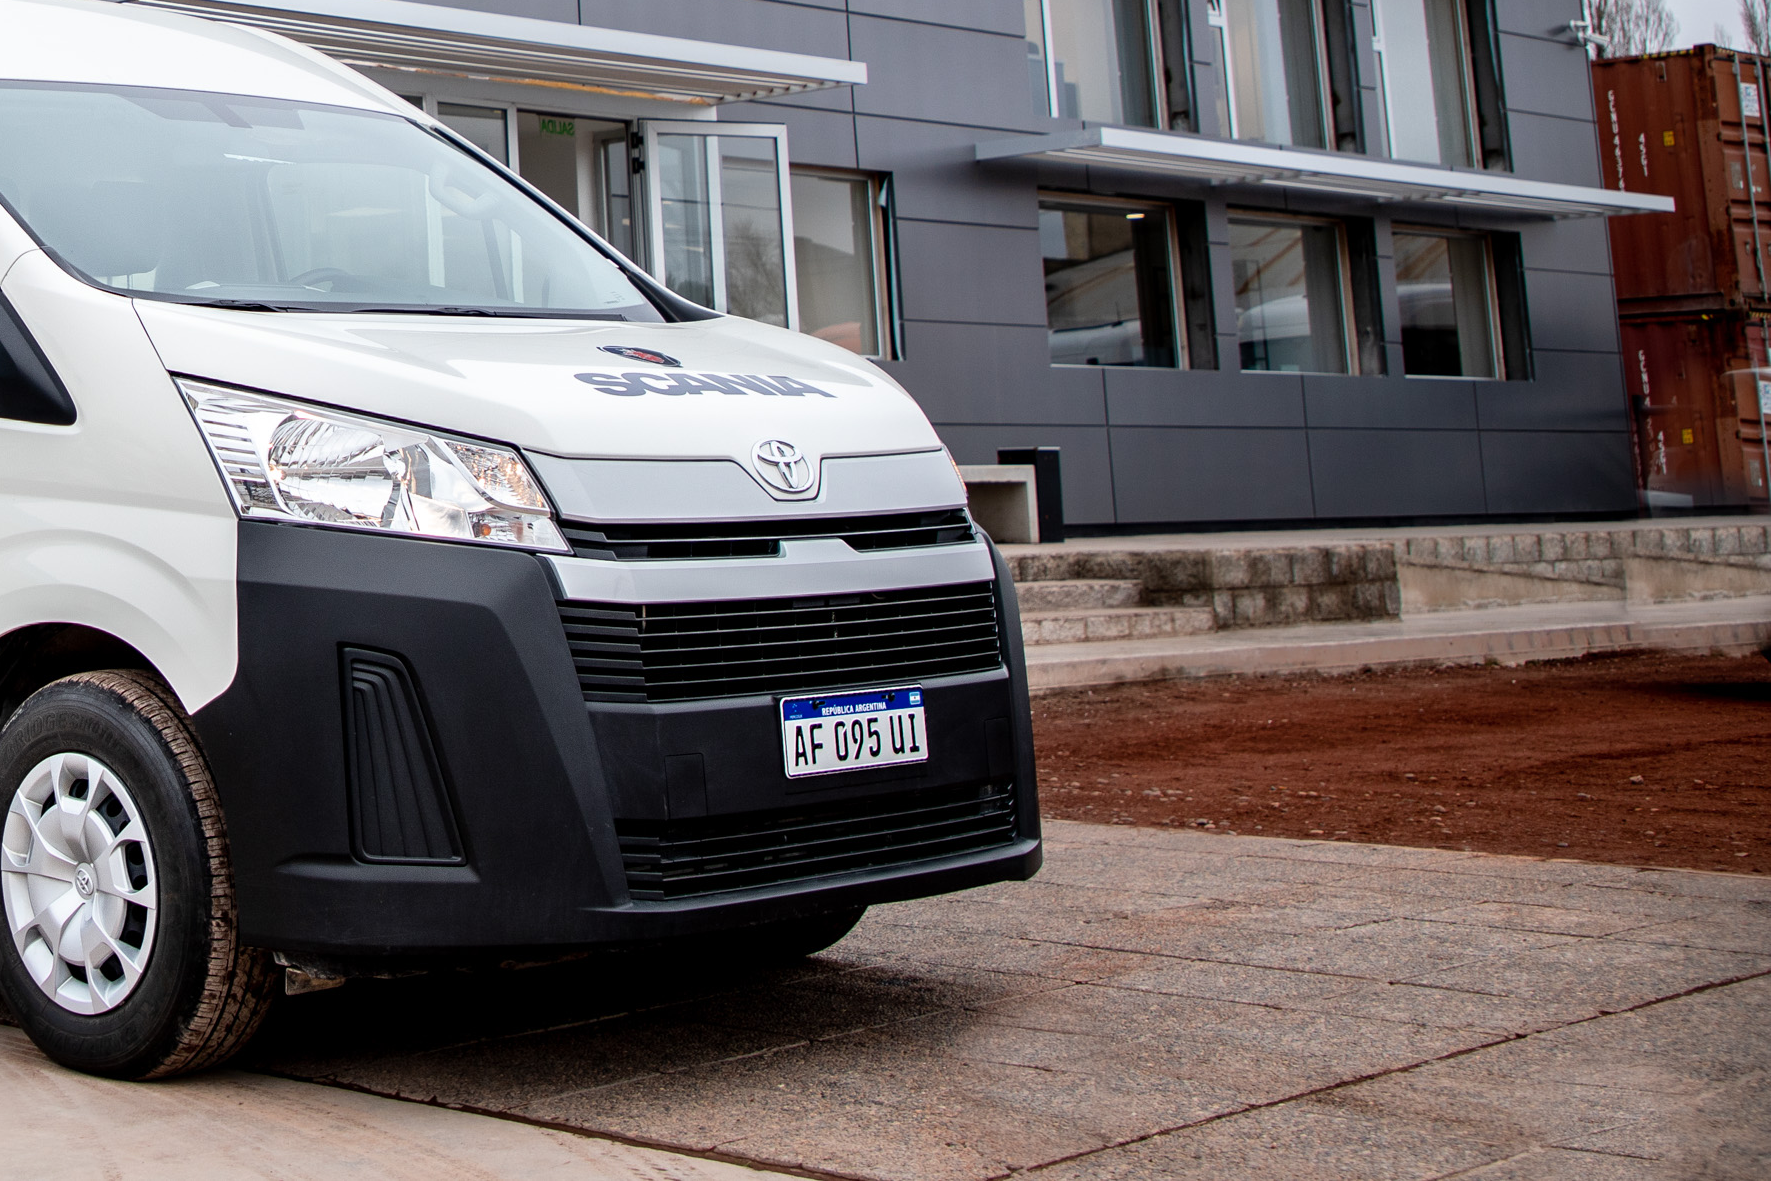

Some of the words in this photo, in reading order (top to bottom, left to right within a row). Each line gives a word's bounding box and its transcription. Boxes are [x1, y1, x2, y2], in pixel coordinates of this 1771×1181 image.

[573, 372, 838, 398] SCANIA
[822, 705, 854, 716] REPÚBLICA
[855, 702, 887, 712] ARGENTINA
[795, 723, 823, 766] AF
[834, 717, 881, 761] 095
[889, 713, 920, 754] UI
